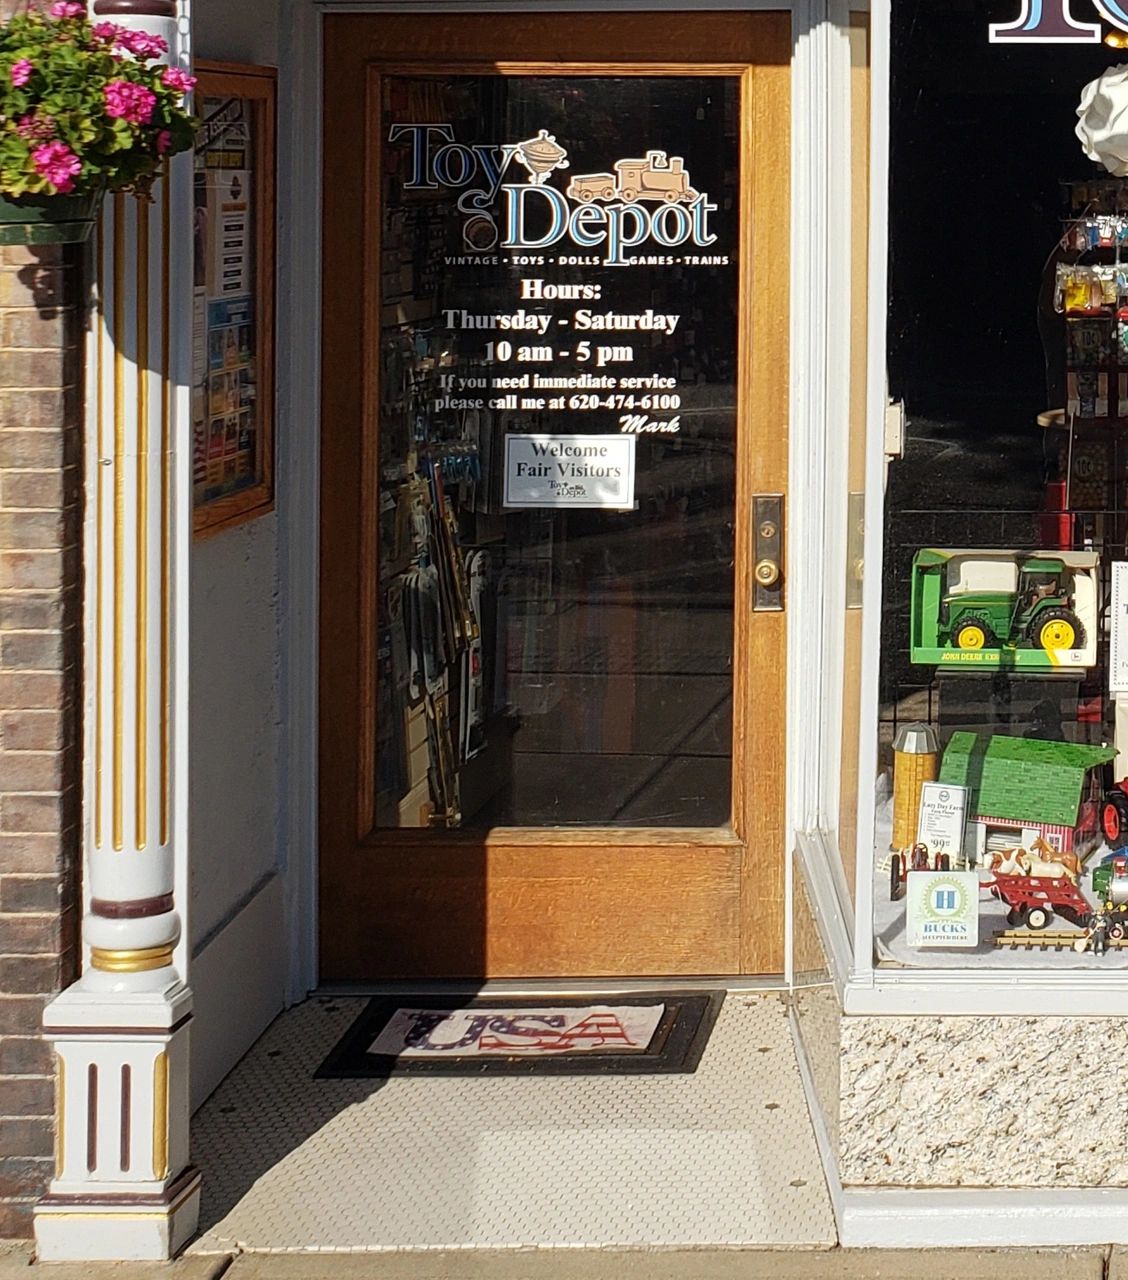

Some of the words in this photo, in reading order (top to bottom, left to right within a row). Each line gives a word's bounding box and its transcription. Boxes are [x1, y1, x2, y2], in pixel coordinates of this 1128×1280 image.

[389, 124, 519, 208] Toy
[502, 184, 718, 267] Depot
[444, 256, 498, 265] VINTAGE
[512, 256, 545, 265] TOYS
[558, 256, 600, 265] DOLLS
[629, 256, 674, 265] GAMES
[684, 256, 729, 265] TRAINS
[520, 278, 602, 300] Hours:
[442, 309, 552, 335] Thursday
[574, 309, 680, 335] Saturday
[485, 341, 513, 361] 10
[517, 345, 553, 361] am
[576, 341, 591, 361] 5
[596, 346, 634, 367] pm
[439, 374, 456, 392] If
[458, 377, 487, 392] you
[491, 373, 530, 389] need
[533, 373, 617, 389] immediate
[620, 373, 677, 389] service
[434, 395, 484, 412] please
[488, 394, 518, 410] call
[521, 397, 546, 410] me
[548, 395, 566, 410] at
[569, 394, 681, 410] 620-474-6100
[619, 413, 681, 433] Mark
[531, 442, 608, 457] Welcome
[516, 462, 552, 477] Fair
[557, 462, 621, 478] Visitors
[561, 487, 587, 498] Depot
[941, 653, 960, 661] JOHN
[961, 653, 983, 661] DEERE
[924, 924, 967, 933] BUCKS
[404, 1013, 638, 1050] USA
